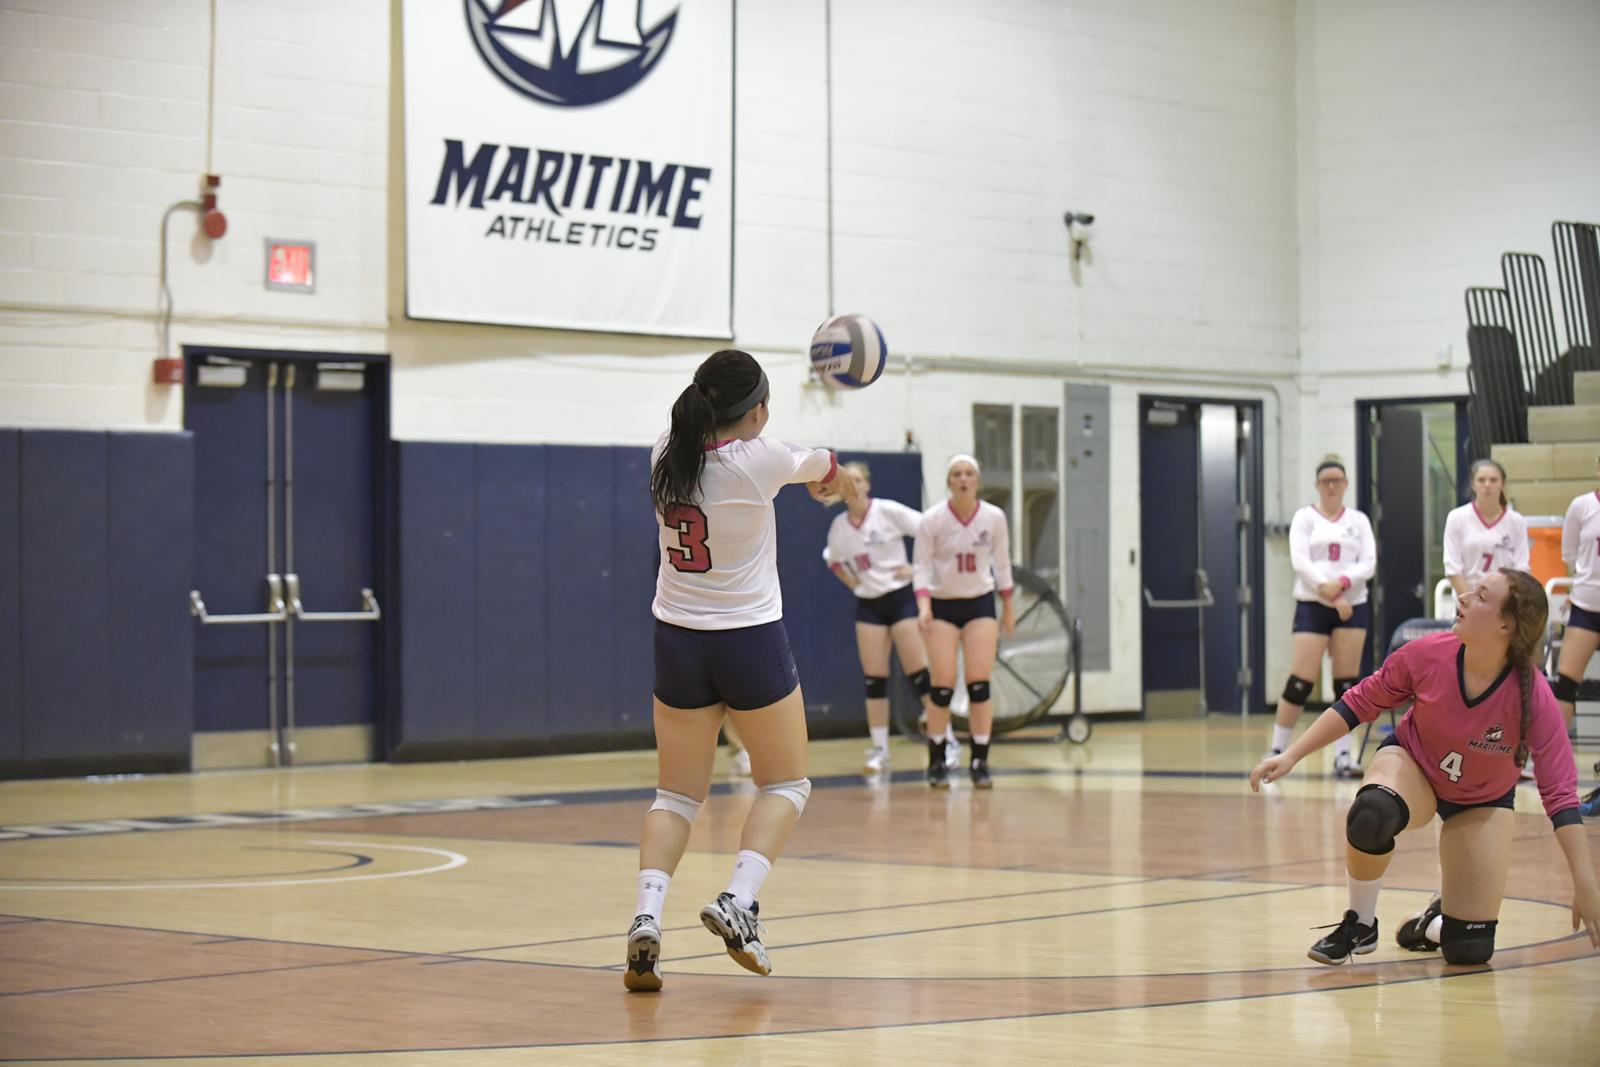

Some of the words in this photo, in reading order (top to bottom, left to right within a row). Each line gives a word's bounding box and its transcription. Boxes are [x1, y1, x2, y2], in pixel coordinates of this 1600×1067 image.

[430, 139, 711, 229] MARITIME
[485, 215, 658, 250] ATHLETICS
[664, 502, 712, 573] 3
[1328, 543, 1341, 561] 9
[1482, 552, 1494, 573] 7
[1467, 740, 1513, 753] MARITIME
[1439, 751, 1464, 783] 4
